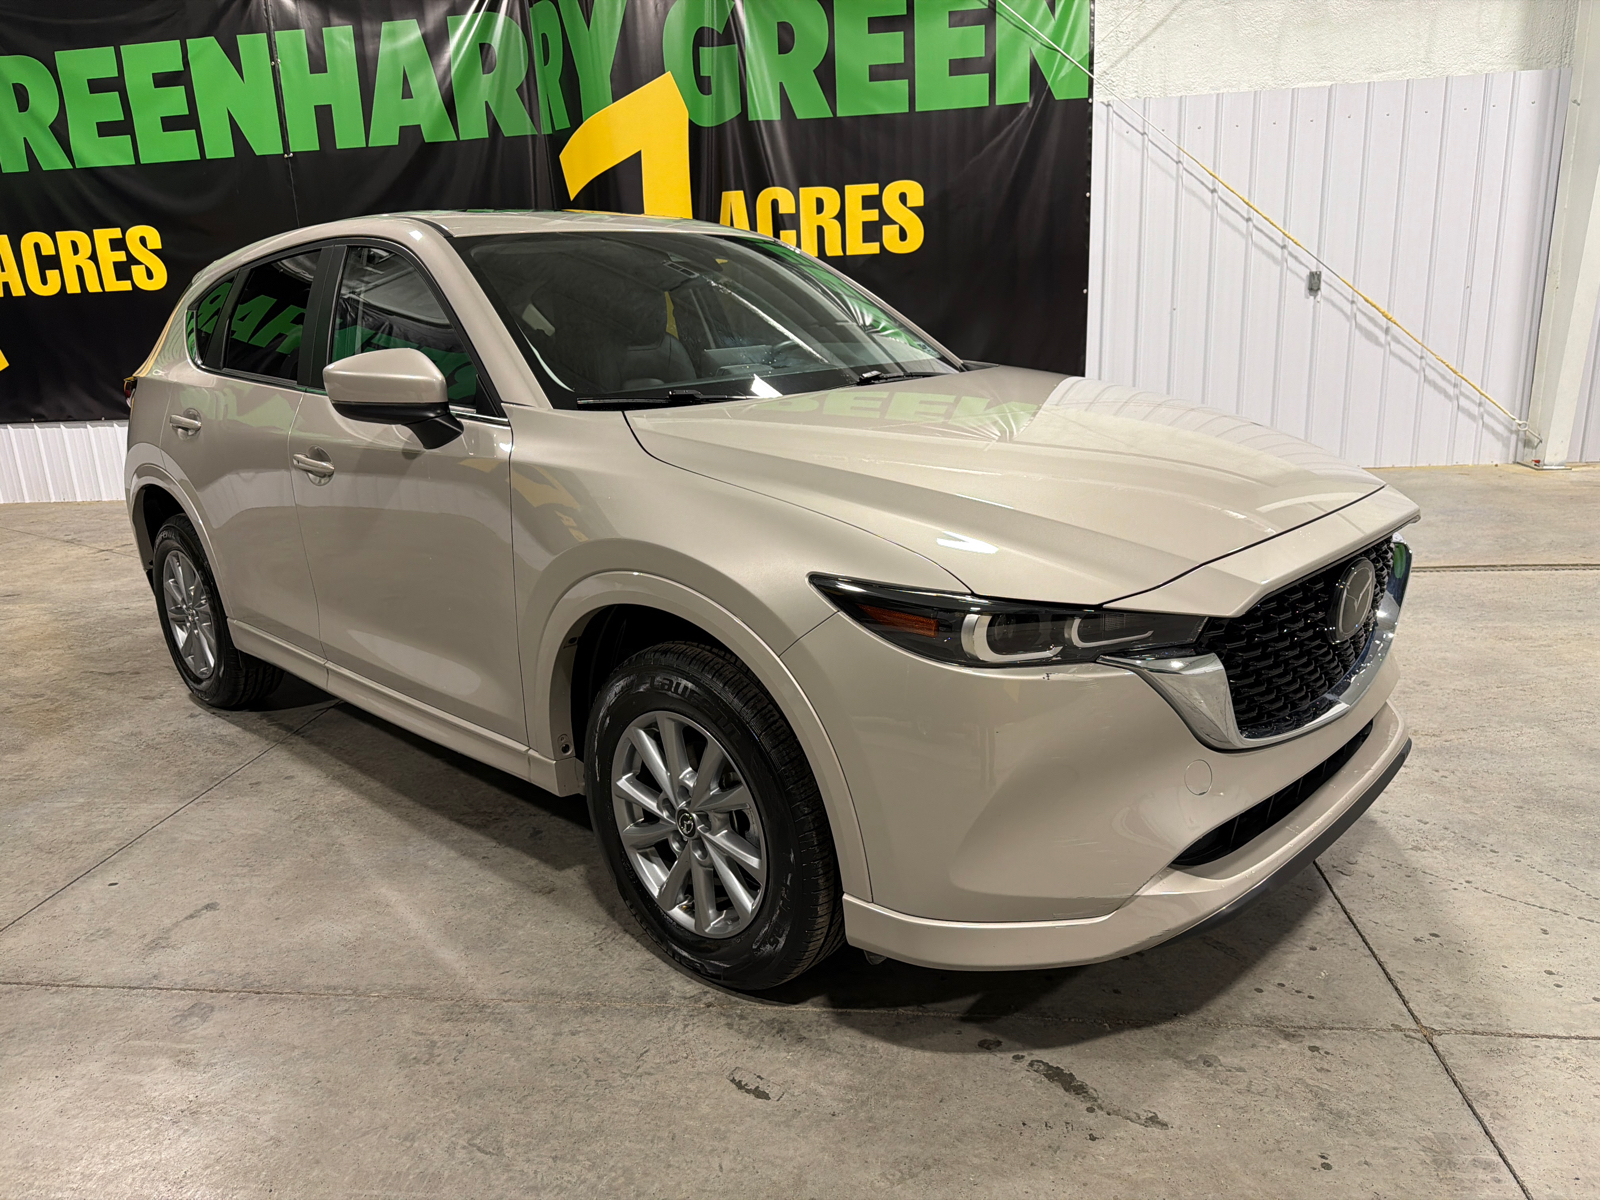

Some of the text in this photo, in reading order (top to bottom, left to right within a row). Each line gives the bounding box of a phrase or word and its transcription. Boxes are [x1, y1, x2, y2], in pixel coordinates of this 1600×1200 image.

[0, 34, 284, 174] REEN
[276, 0, 1090, 153] HARRY GREEN
[0, 225, 168, 298] ACRES
[719, 180, 925, 257] ACRES
